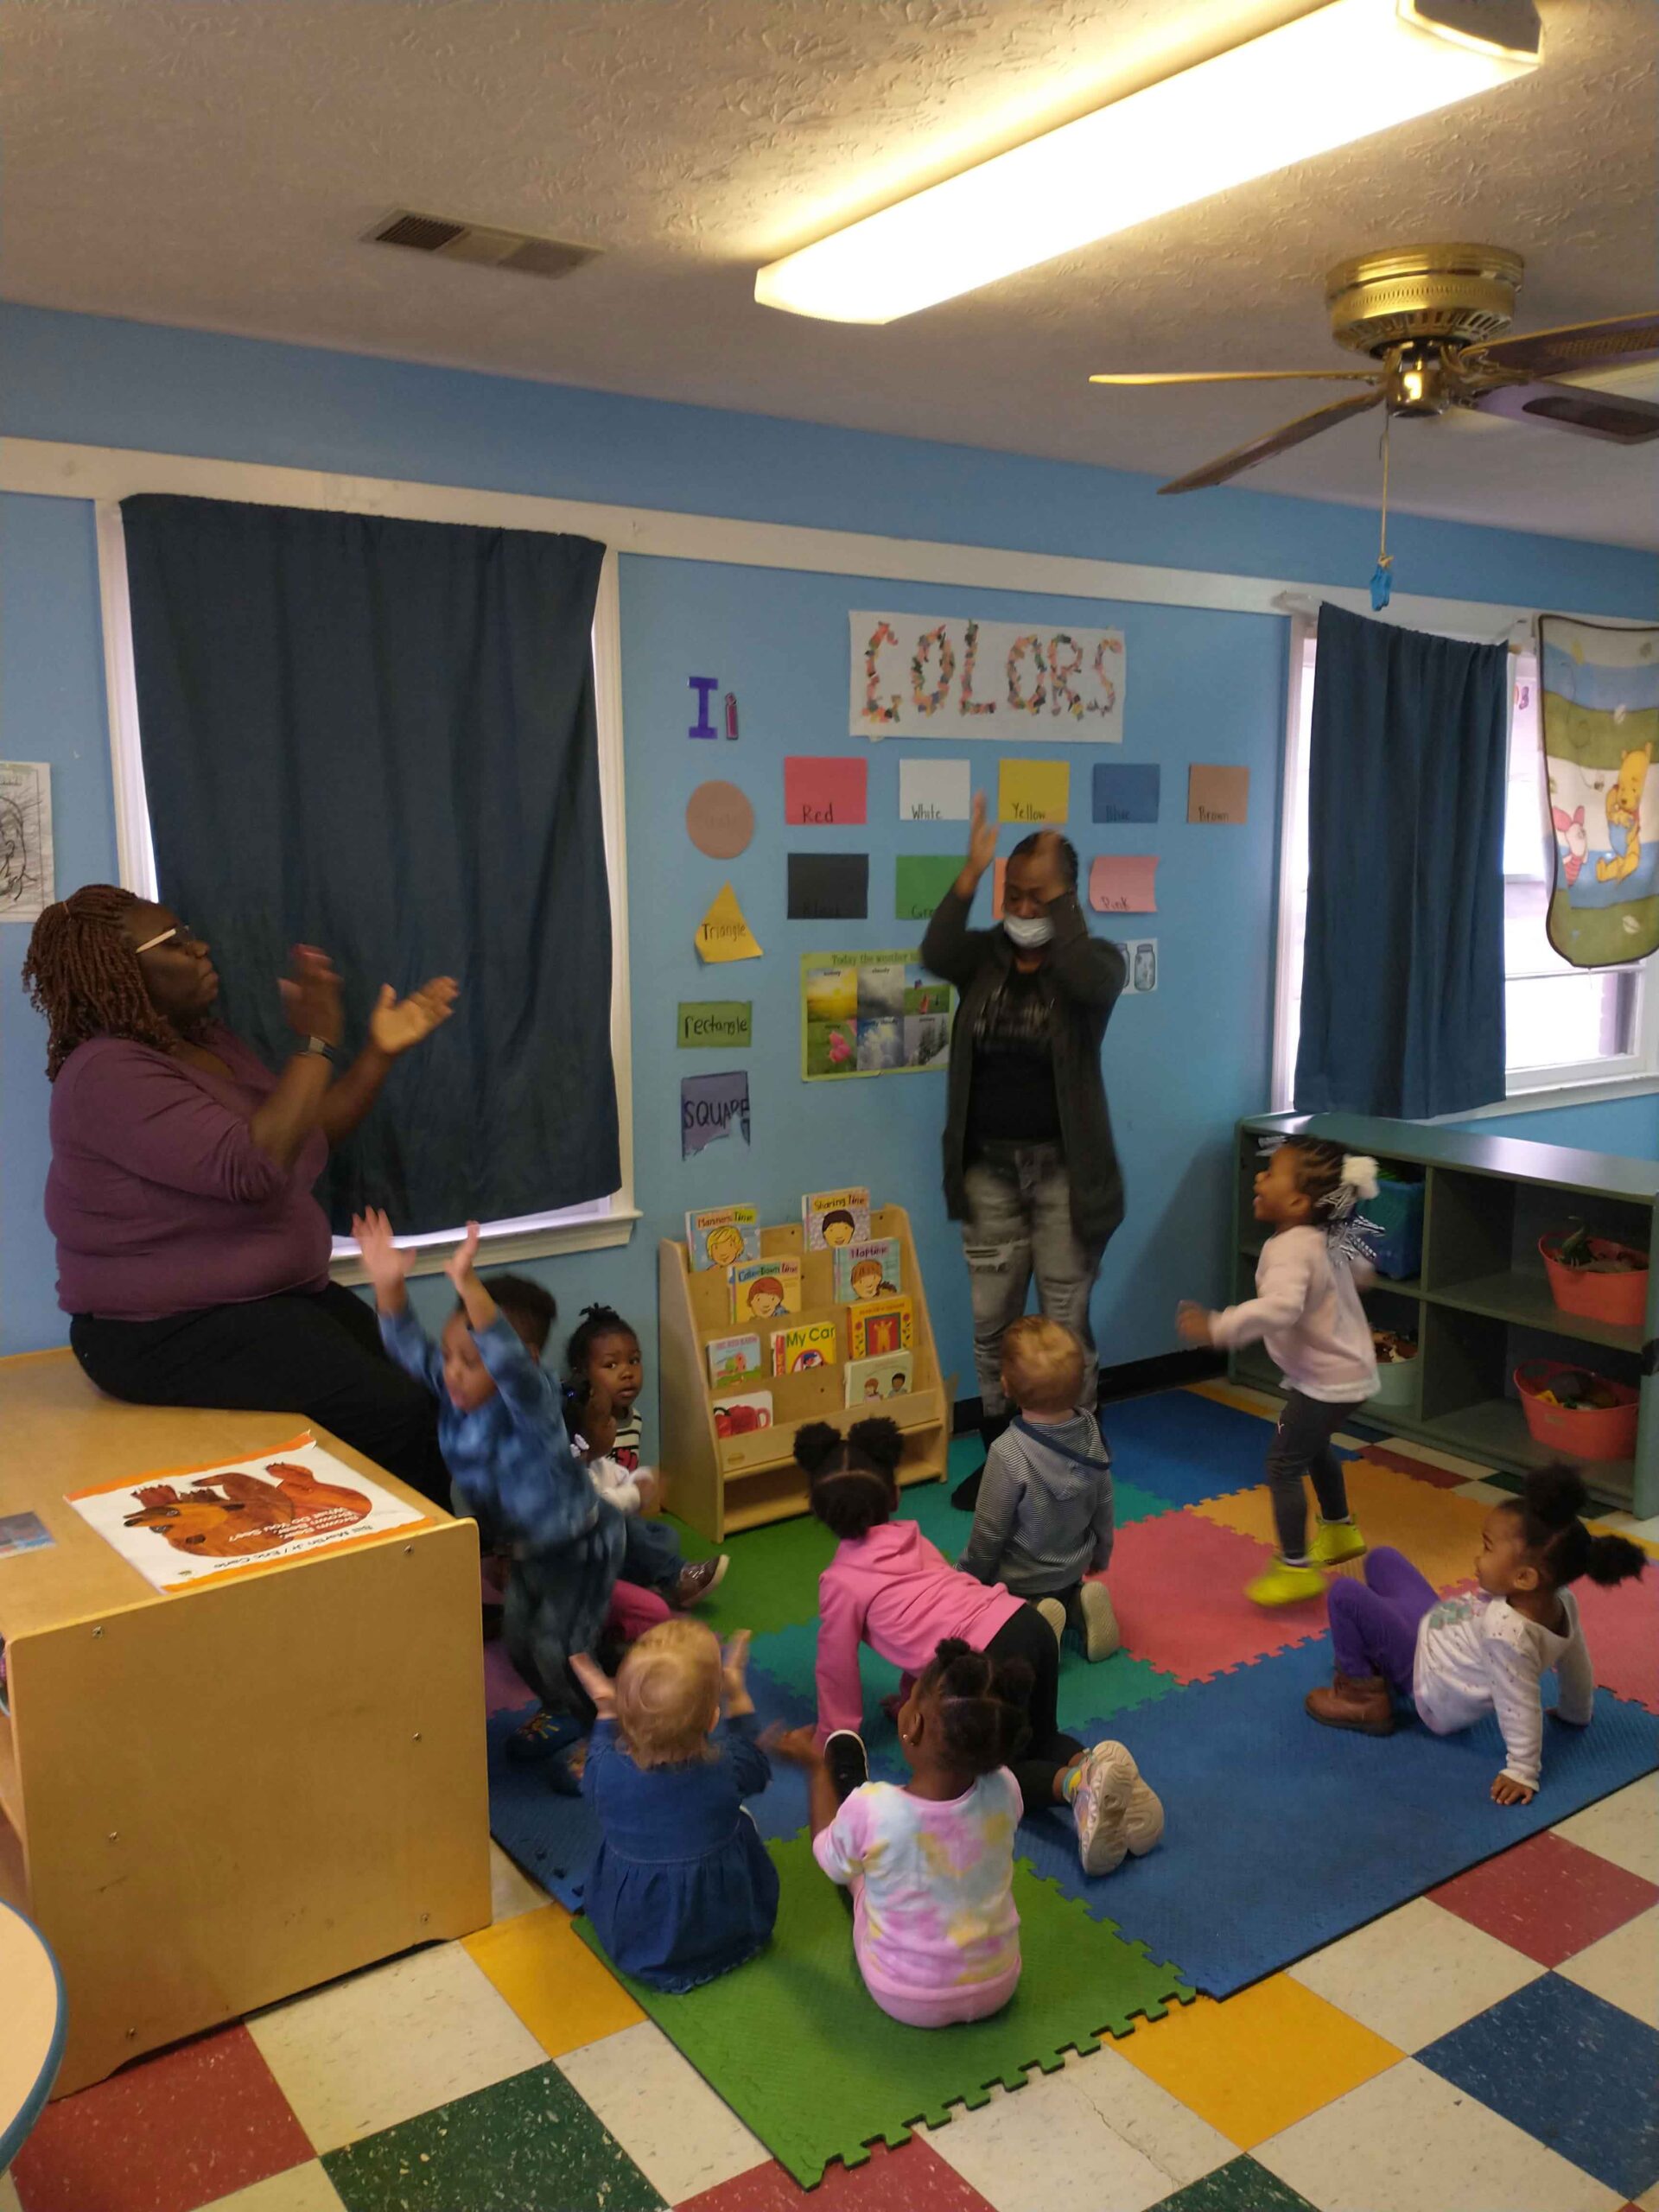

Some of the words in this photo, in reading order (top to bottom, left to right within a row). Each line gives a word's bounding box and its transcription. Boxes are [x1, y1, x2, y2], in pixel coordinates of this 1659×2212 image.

[862, 619, 1122, 722] COLORS
[802, 802, 834, 823] Red
[912, 803, 942, 820] White
[1011, 802, 1046, 821] Yellow
[1101, 896, 1130, 912] Pink
[702, 922, 746, 942] Triangle
[786, 1331, 805, 1348] My
[809, 1326, 835, 1341] Car
